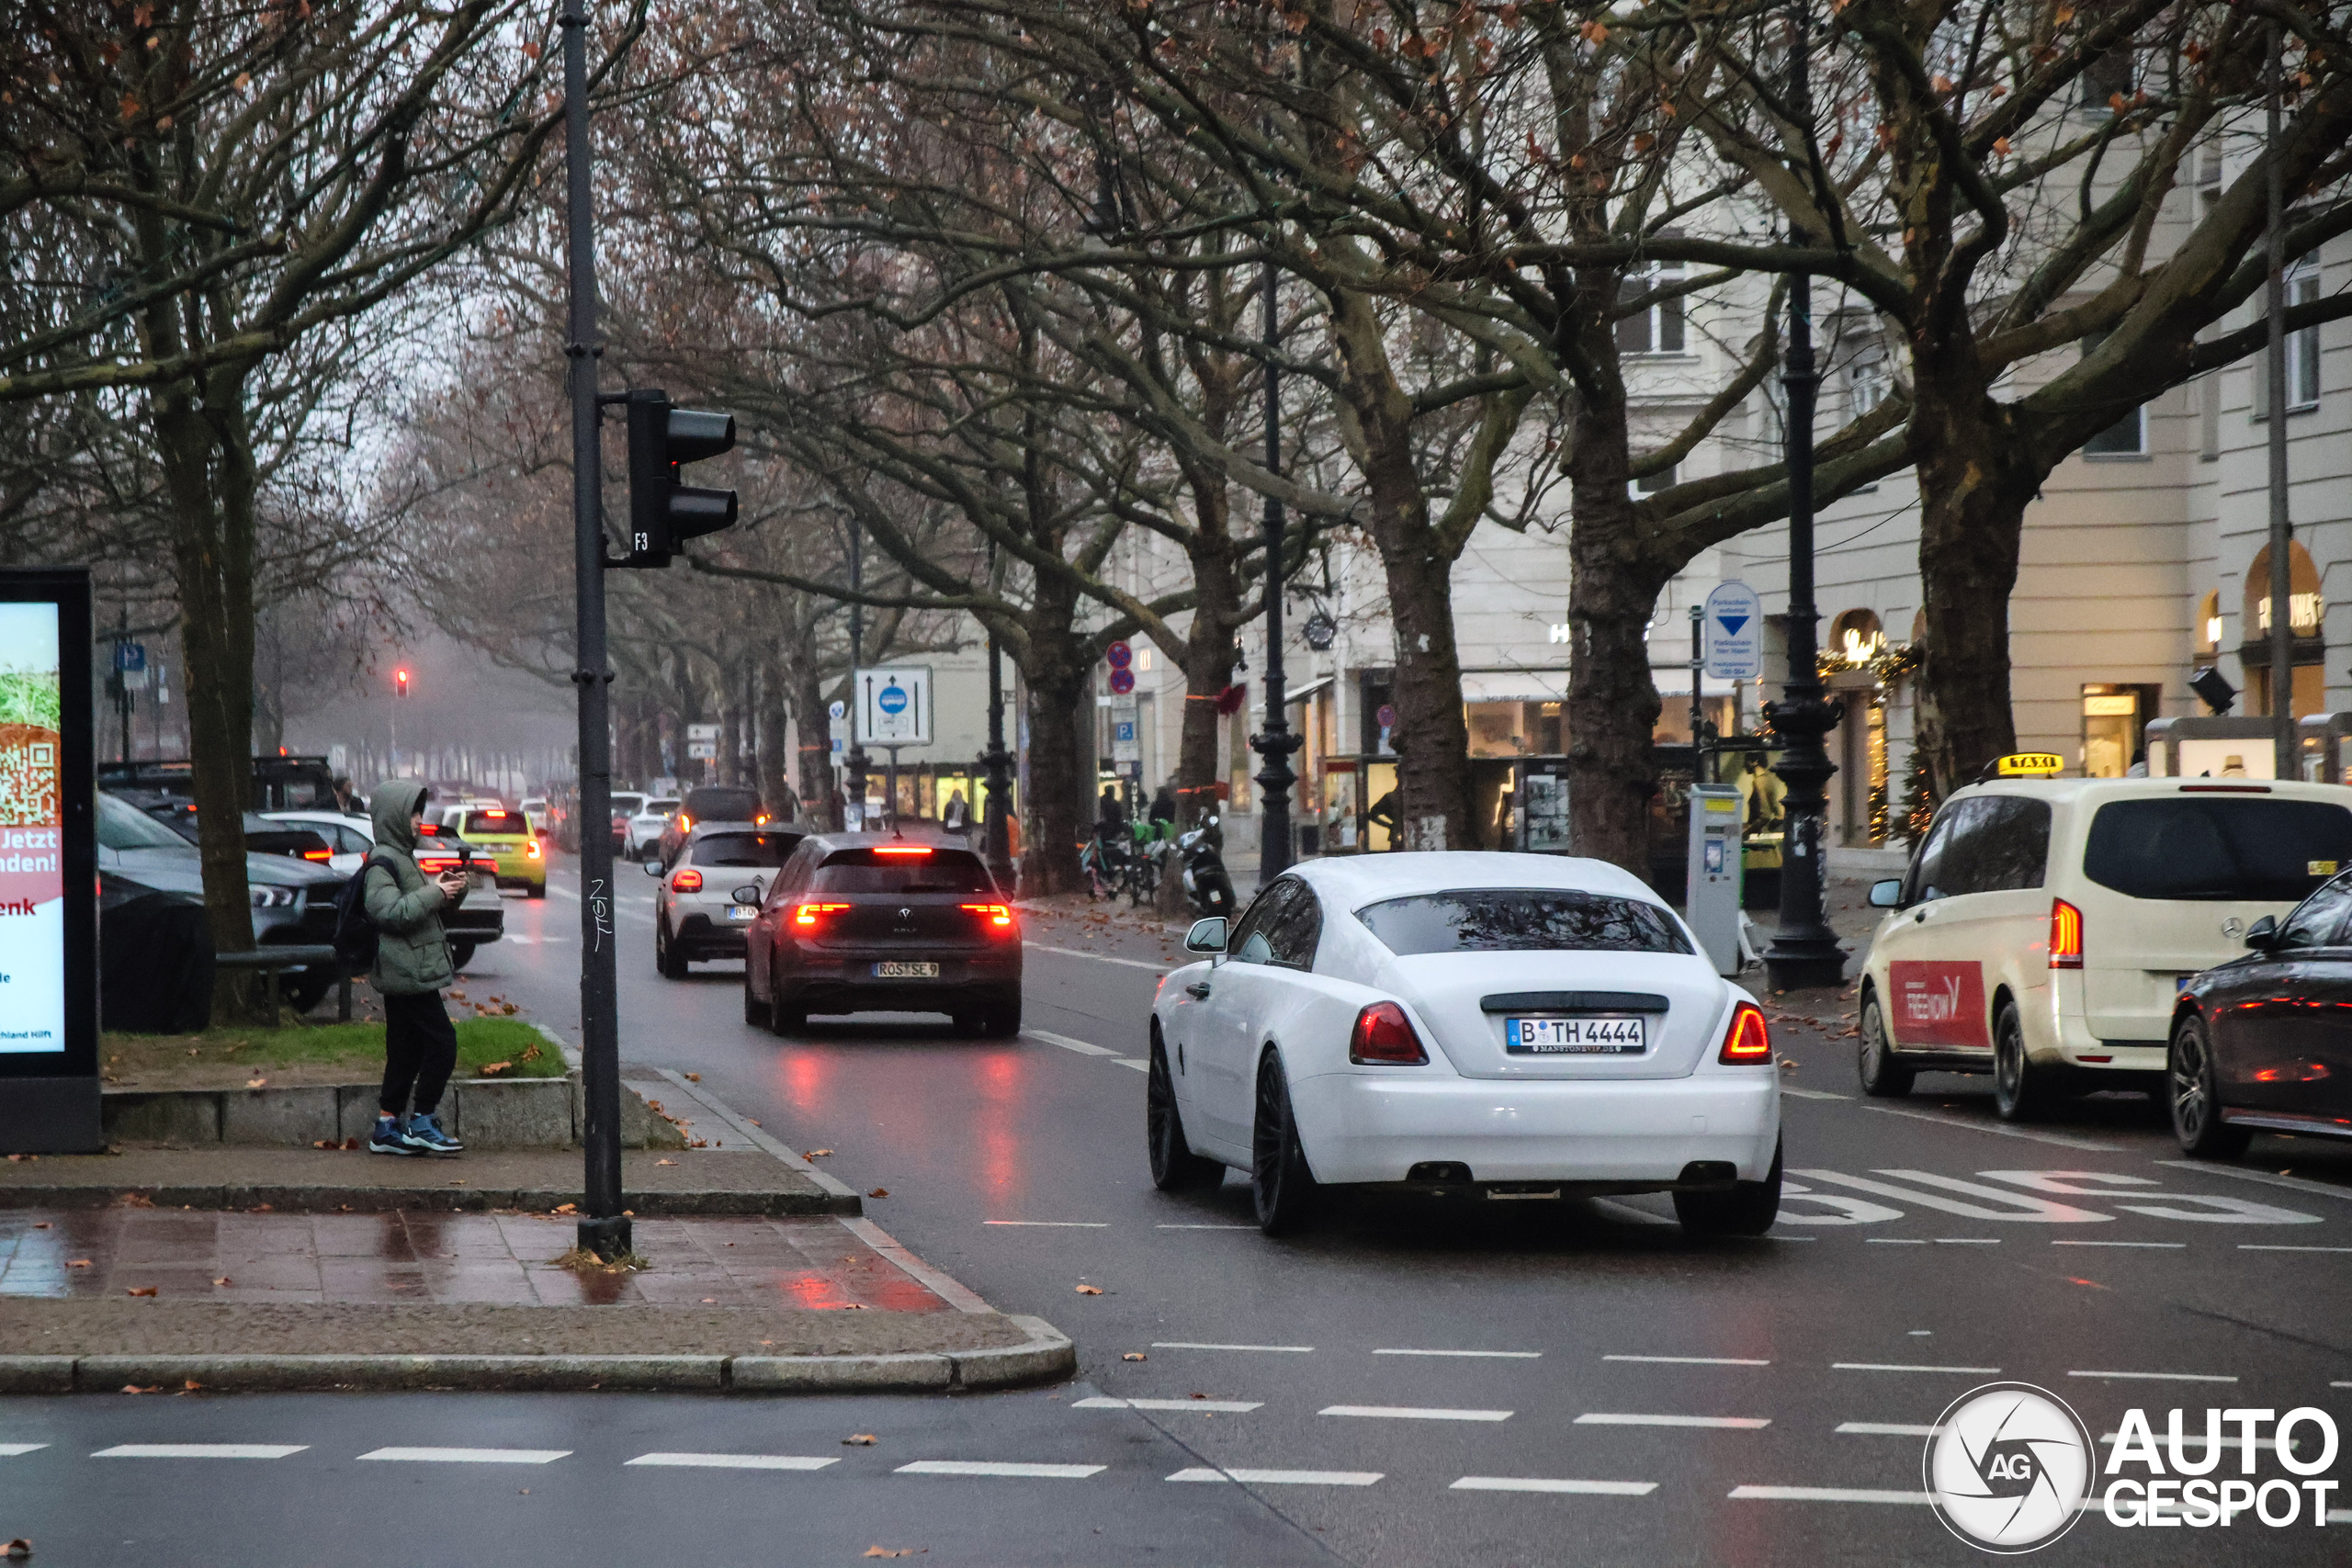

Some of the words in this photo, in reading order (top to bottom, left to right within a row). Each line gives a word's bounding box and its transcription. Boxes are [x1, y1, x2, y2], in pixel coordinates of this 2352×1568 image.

[635, 532, 648, 551] F3
[2014, 757, 2052, 768] TAXI
[2, 829, 57, 850] Jetzt
[879, 964, 903, 976] ROS
[911, 964, 927, 976] SE
[930, 964, 938, 976] 9
[1521, 1021, 1535, 1043] B
[1551, 1021, 1580, 1043] TH
[1586, 1021, 1640, 1043] 4444
